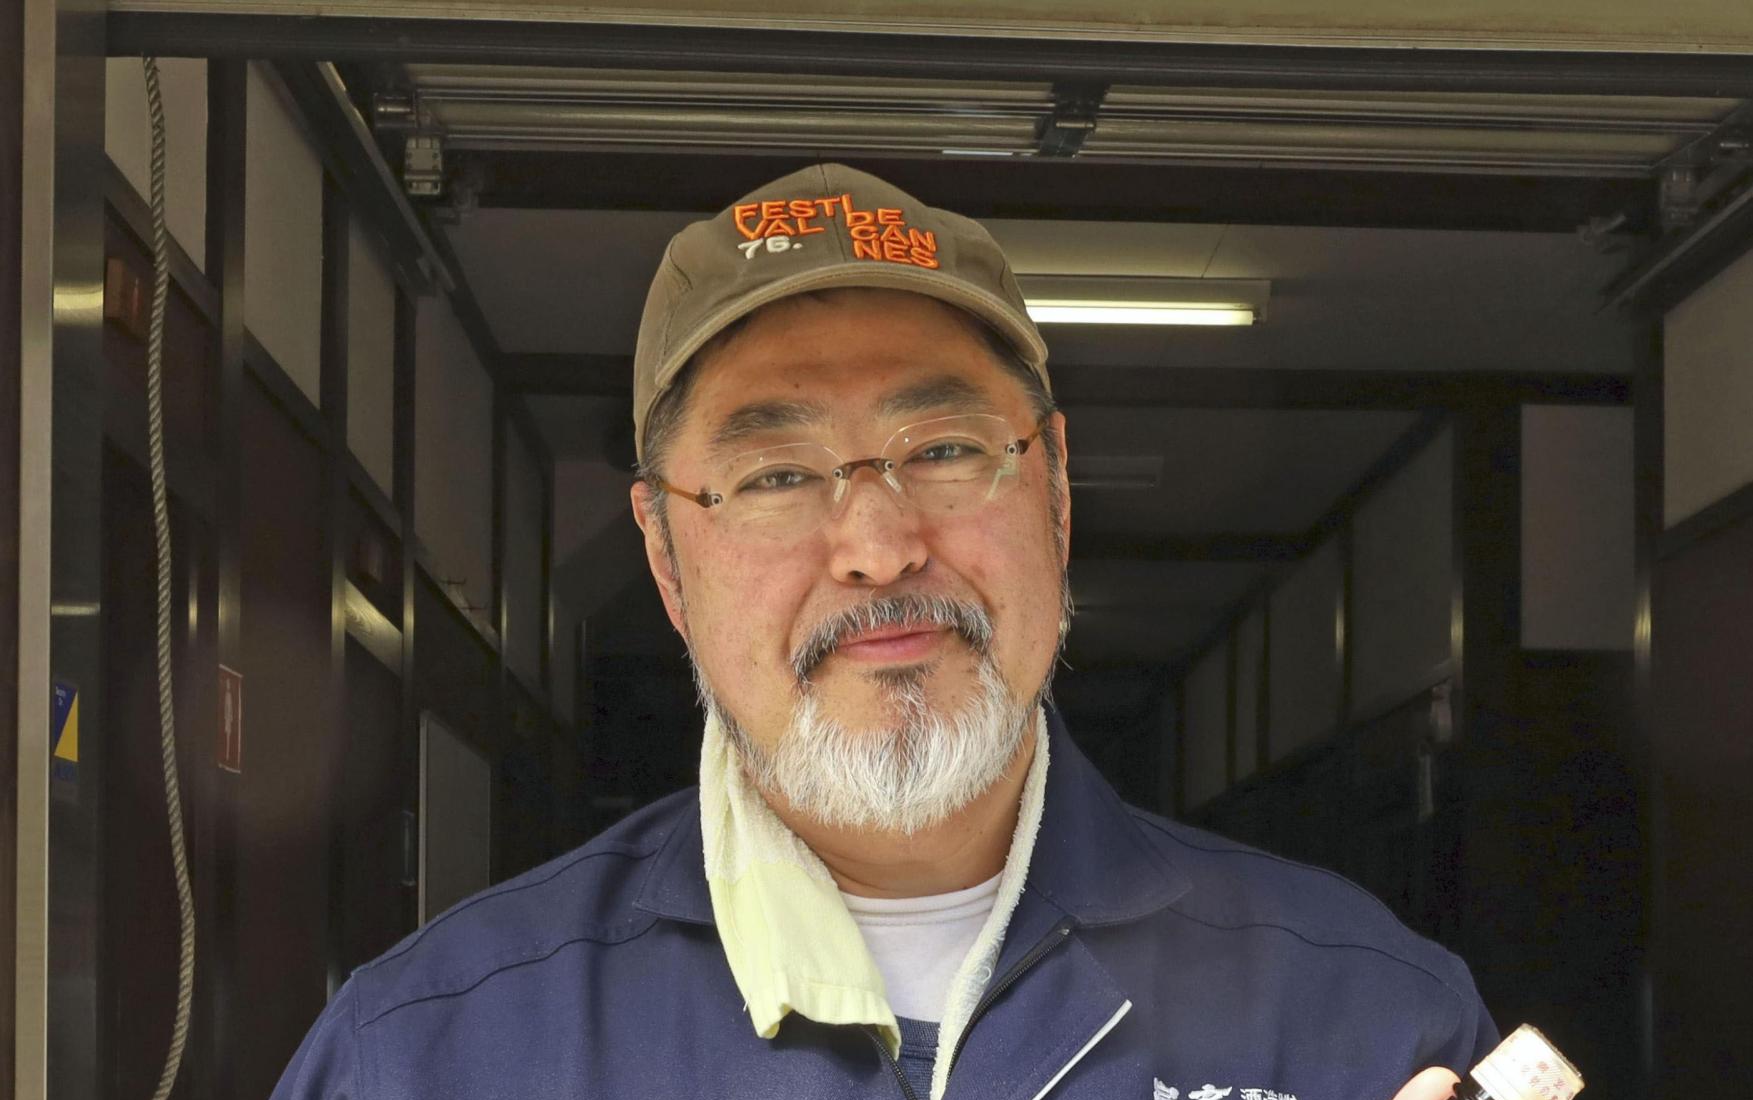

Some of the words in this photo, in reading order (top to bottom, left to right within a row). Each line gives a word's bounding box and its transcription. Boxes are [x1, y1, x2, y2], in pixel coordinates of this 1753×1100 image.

[734, 194, 853, 219] FESTI
[846, 207, 906, 228] DE
[736, 217, 824, 241] VAL
[850, 225, 937, 254] CAN
[853, 240, 939, 269] NES
